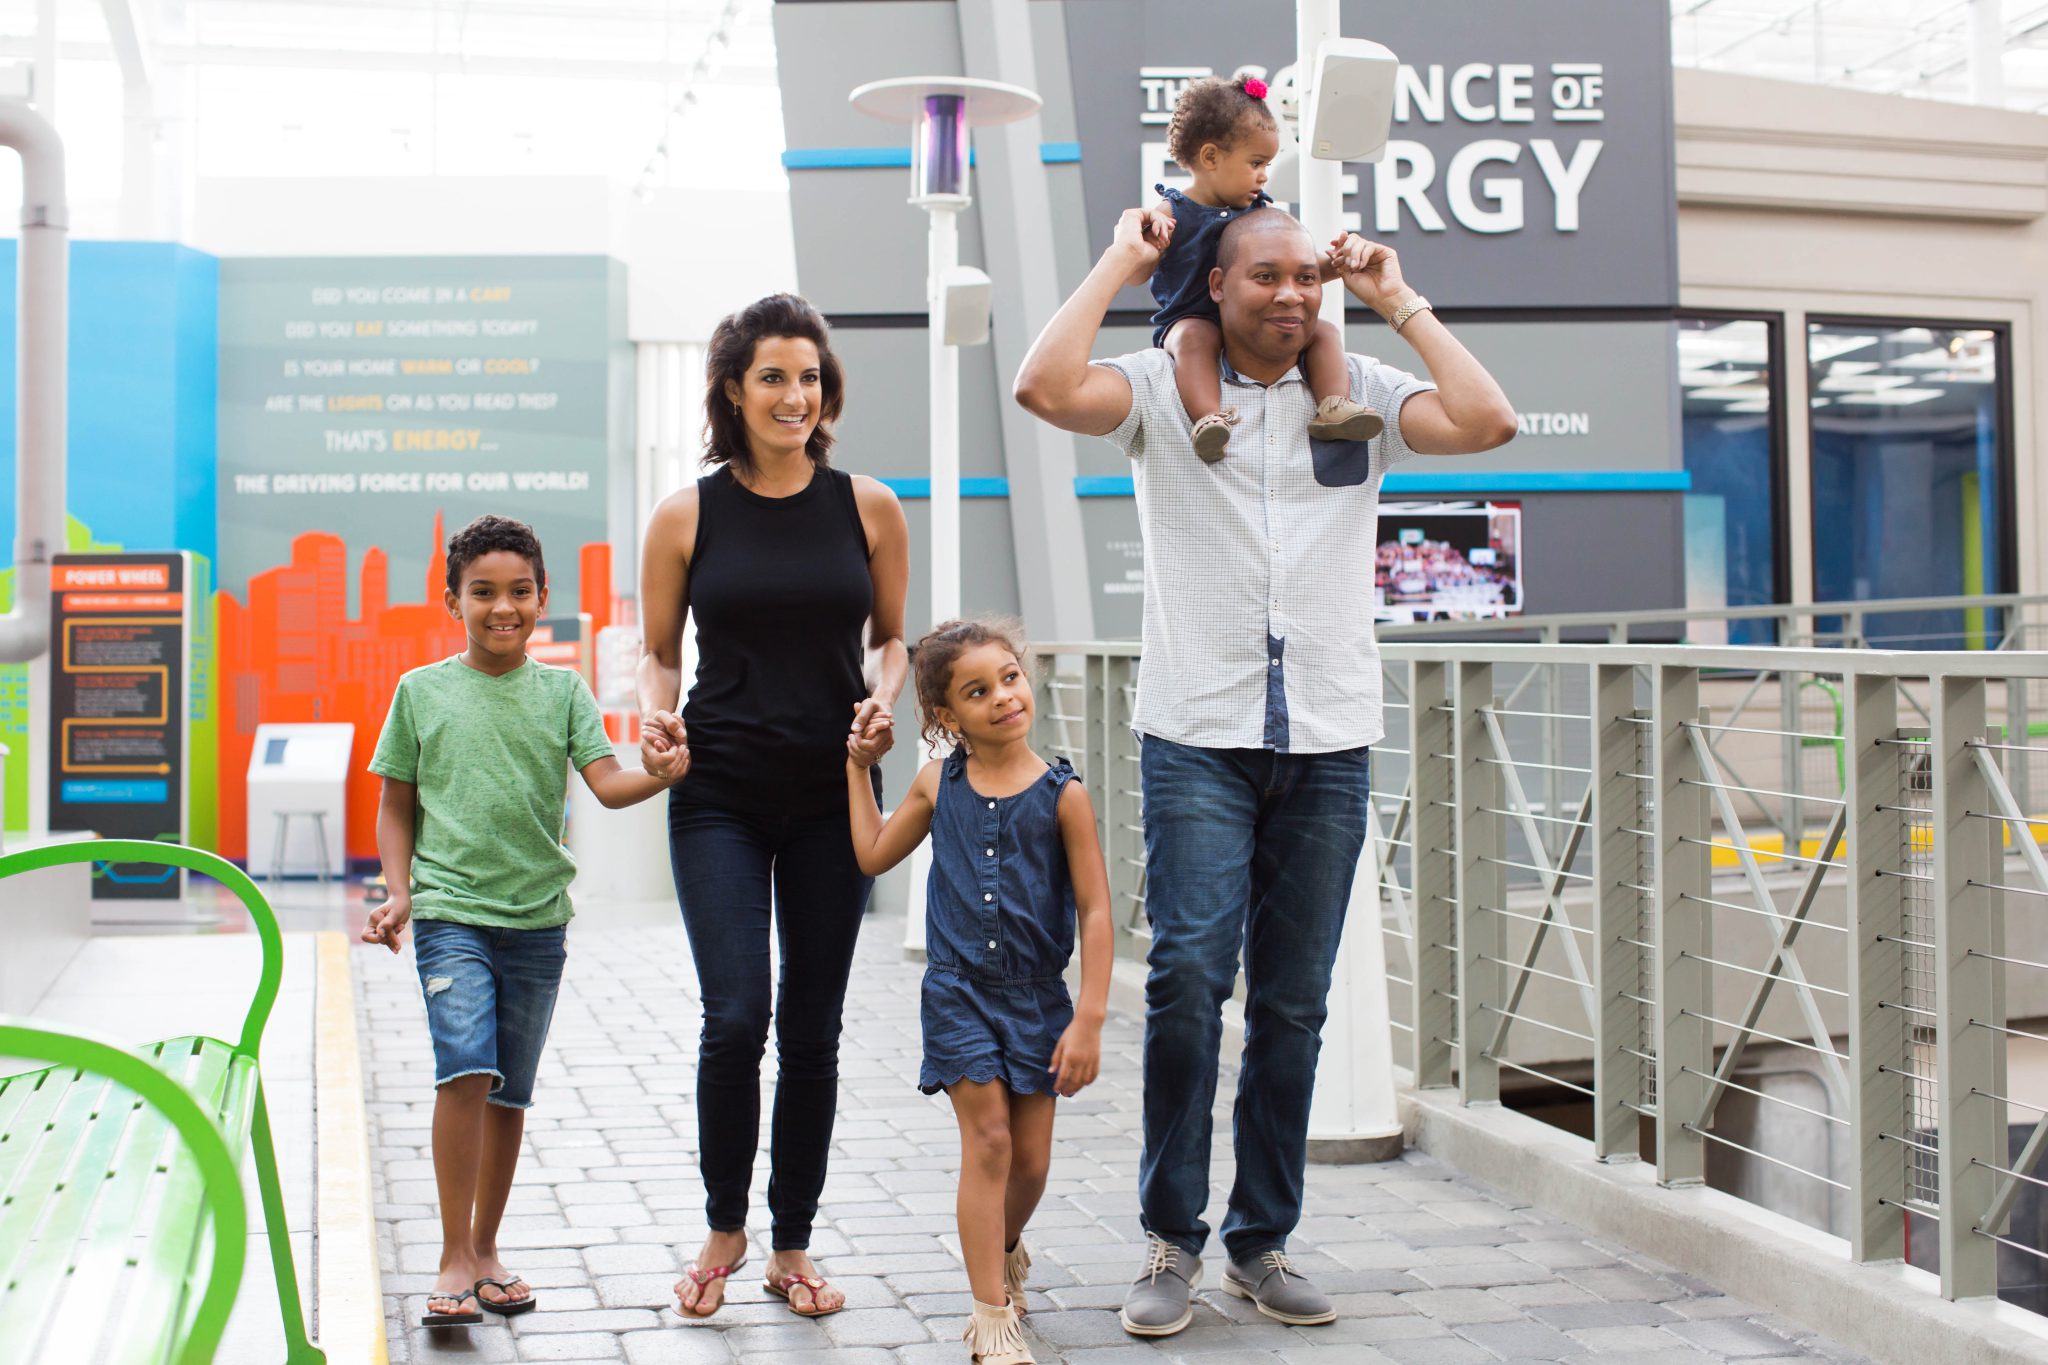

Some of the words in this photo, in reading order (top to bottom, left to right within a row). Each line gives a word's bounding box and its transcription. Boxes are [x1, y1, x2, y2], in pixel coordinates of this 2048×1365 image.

[1551, 76, 1603, 109] OF
[1141, 138, 1603, 234] ERGY
[312, 287, 342, 304] DID
[346, 287, 380, 304] YOU
[382, 286, 431, 304] COME
[286, 320, 316, 338] DID
[319, 320, 352, 337] YOU
[355, 320, 384, 337] EAT
[387, 320, 477, 337] SOMETHING
[481, 319, 538, 337] TODAY?
[284, 359, 299, 377] IS
[303, 359, 346, 376] YOUR
[349, 359, 397, 375] HOME
[400, 358, 453, 375] WARM
[456, 358, 481, 375] OR
[484, 358, 540, 375] COOL?
[264, 394, 293, 412] ARE
[297, 394, 324, 412] THE
[327, 394, 384, 412] LIGHTS
[386, 394, 412, 411] ON
[415, 394, 434, 411] AS
[437, 393, 471, 411] YOU
[473, 392, 515, 410] READ
[324, 429, 387, 452] THAT'S
[235, 474, 268, 494] THE
[273, 472, 356, 494] DRIVING
[360, 472, 421, 493] FORCE
[425, 472, 463, 492] FOR
[467, 472, 508, 491] OUR
[512, 472, 589, 491] WORLD!
[65, 570, 116, 585] POWER
[118, 569, 164, 584] WHEEL
